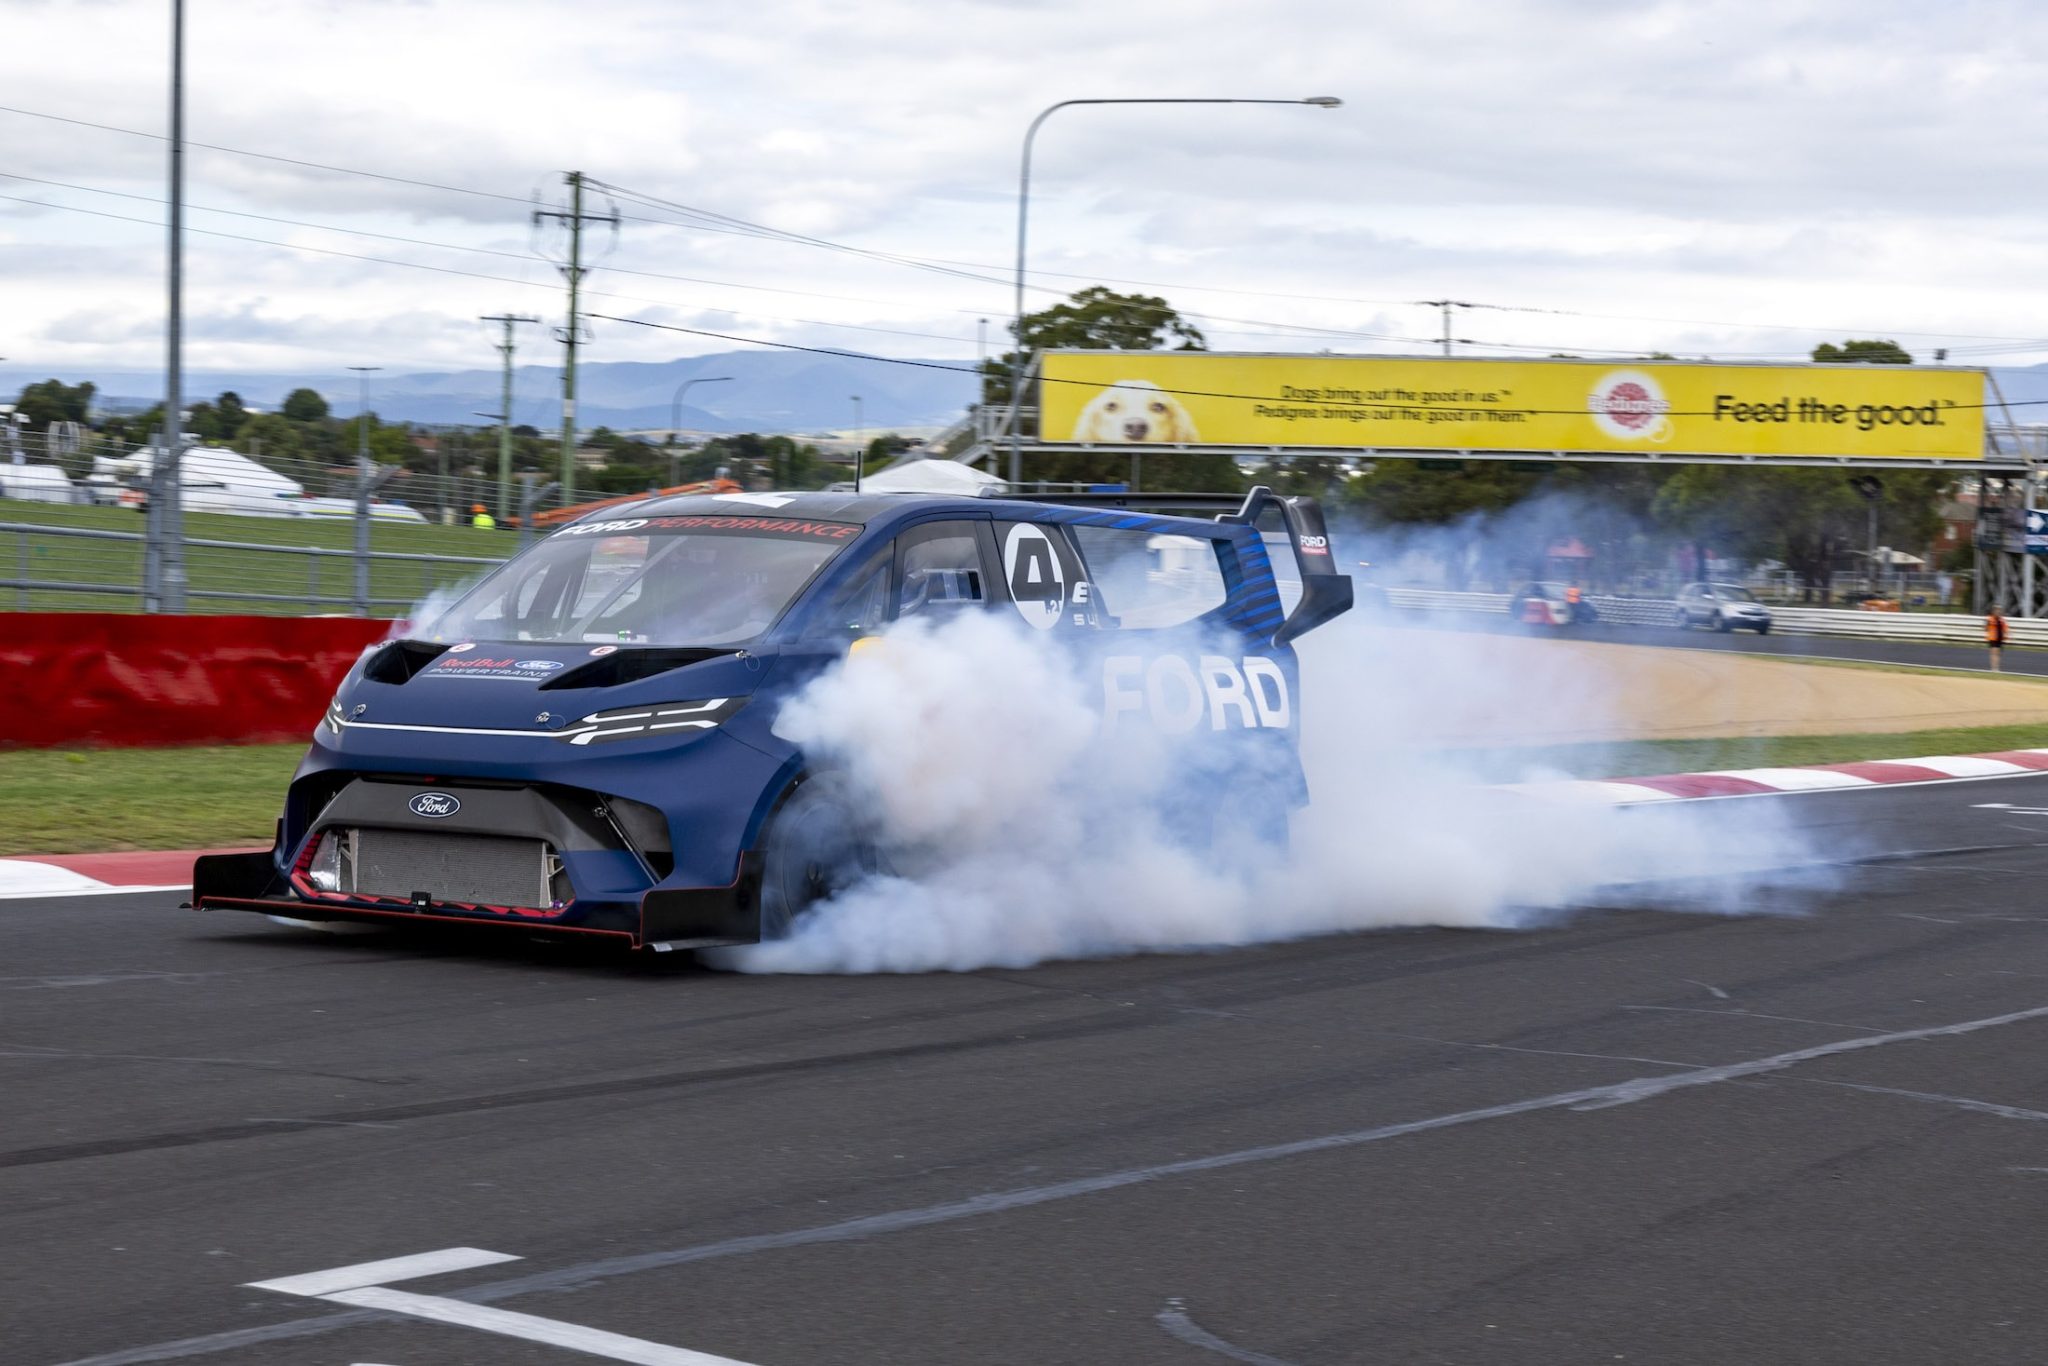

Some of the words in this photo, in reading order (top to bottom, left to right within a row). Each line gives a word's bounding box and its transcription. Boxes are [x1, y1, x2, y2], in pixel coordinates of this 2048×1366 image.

[1281, 385, 1320, 402] Dogs
[1323, 386, 1361, 403] bring
[1366, 387, 1388, 401] out
[1394, 388, 1416, 401] the
[1420, 389, 1460, 404] good
[1321, 406, 1368, 423] brings
[1400, 408, 1422, 422] the
[1427, 409, 1465, 425] good
[1714, 395, 1789, 422] Feed
[1797, 397, 1848, 424] the
[551, 518, 648, 538] FORD
[645, 518, 860, 539] PERFORMANCE
[1300, 535, 1327, 548] FORD
[428, 668, 551, 678] POWERTRAINS
[1103, 654, 1290, 738] FORD
[417, 795, 451, 813] Ford
